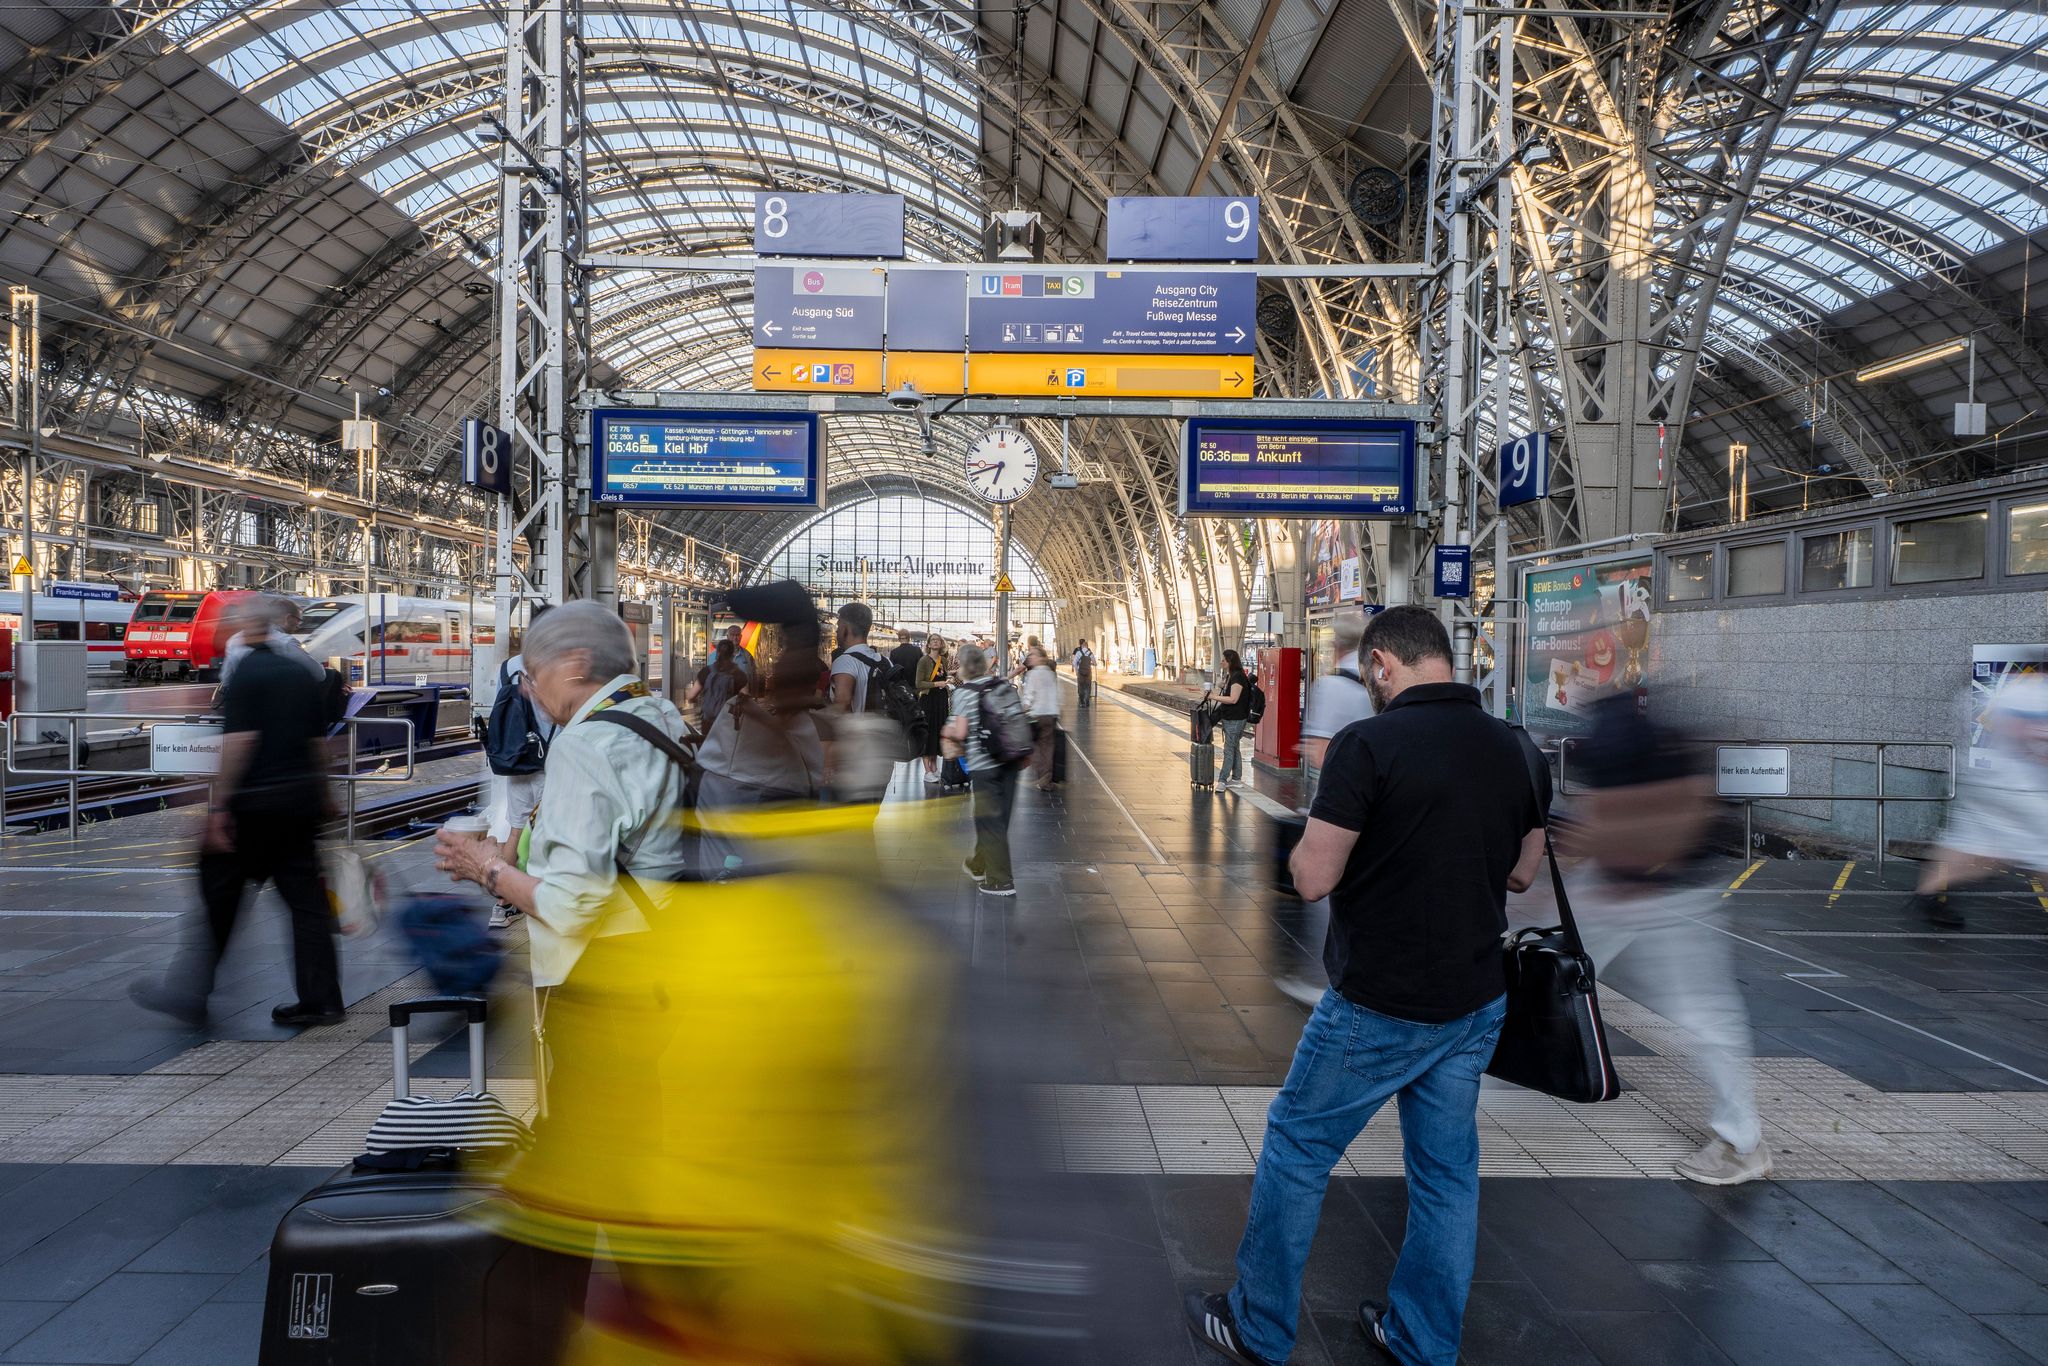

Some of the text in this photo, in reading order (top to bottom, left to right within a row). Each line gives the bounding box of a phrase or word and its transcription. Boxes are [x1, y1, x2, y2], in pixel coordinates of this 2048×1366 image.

[763, 197, 788, 238] 8
[1224, 201, 1250, 243] 9
[985, 277, 998, 294] U
[1067, 277, 1082, 295] S
[1155, 285, 1218, 297] Ausgang City
[1152, 298, 1217, 308] ReiseZentrum
[792, 307, 854, 319] Ausgang Süd
[1146, 311, 1217, 323] Fußweg Messe
[813, 365, 826, 382] P
[1072, 373, 1081, 386] P
[664, 427, 715, 435] Kassel-Wilhelmsh
[720, 428, 749, 436] Göttingen
[664, 435, 714, 443] Hamburg-Harburg
[481, 425, 498, 474] 8
[608, 442, 639, 452] 06:46
[664, 442, 708, 454] Kiel Hbf
[1200, 450, 1231, 461] 06:36
[1256, 451, 1302, 463] Ankunft
[1512, 438, 1530, 488] 9
[600, 493, 617, 501] Gleis
[816, 554, 985, 578] Frankfurter Allgemeine
[55, 588, 82, 596] Frankfurt
[1533, 580, 1571, 593] REWE Bonus
[1534, 598, 1572, 615] Schnapp
[1537, 617, 1581, 631] dir deinen
[1531, 636, 1581, 651] Fan-Bonus!
[409, 647, 432, 663] ICE
[156, 744, 170, 752] Hier
[172, 744, 187, 752] kein
[1751, 767, 1785, 775] Aufenthalt!
